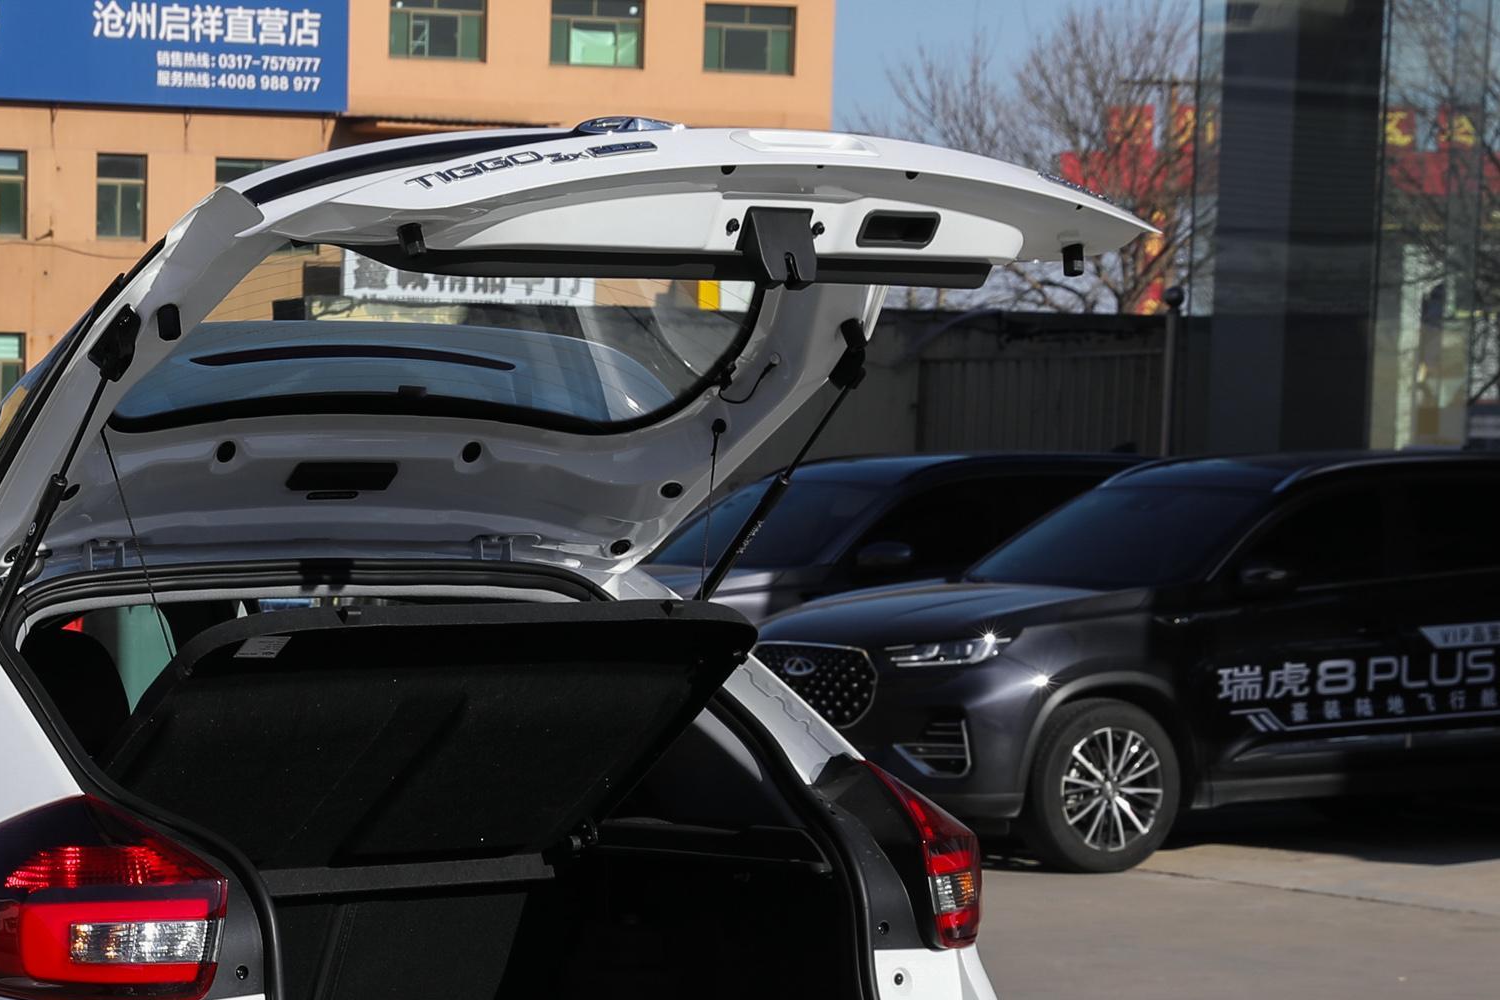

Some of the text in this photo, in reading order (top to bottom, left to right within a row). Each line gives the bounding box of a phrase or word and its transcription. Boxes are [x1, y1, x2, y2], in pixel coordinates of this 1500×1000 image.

[92, 0, 322, 48] 沧州启祥直营店
[293, 76, 321, 93] 977
[404, 151, 545, 190] TIGGO
[1217, 649, 1495, 702] 瑞虎8 PLUS
